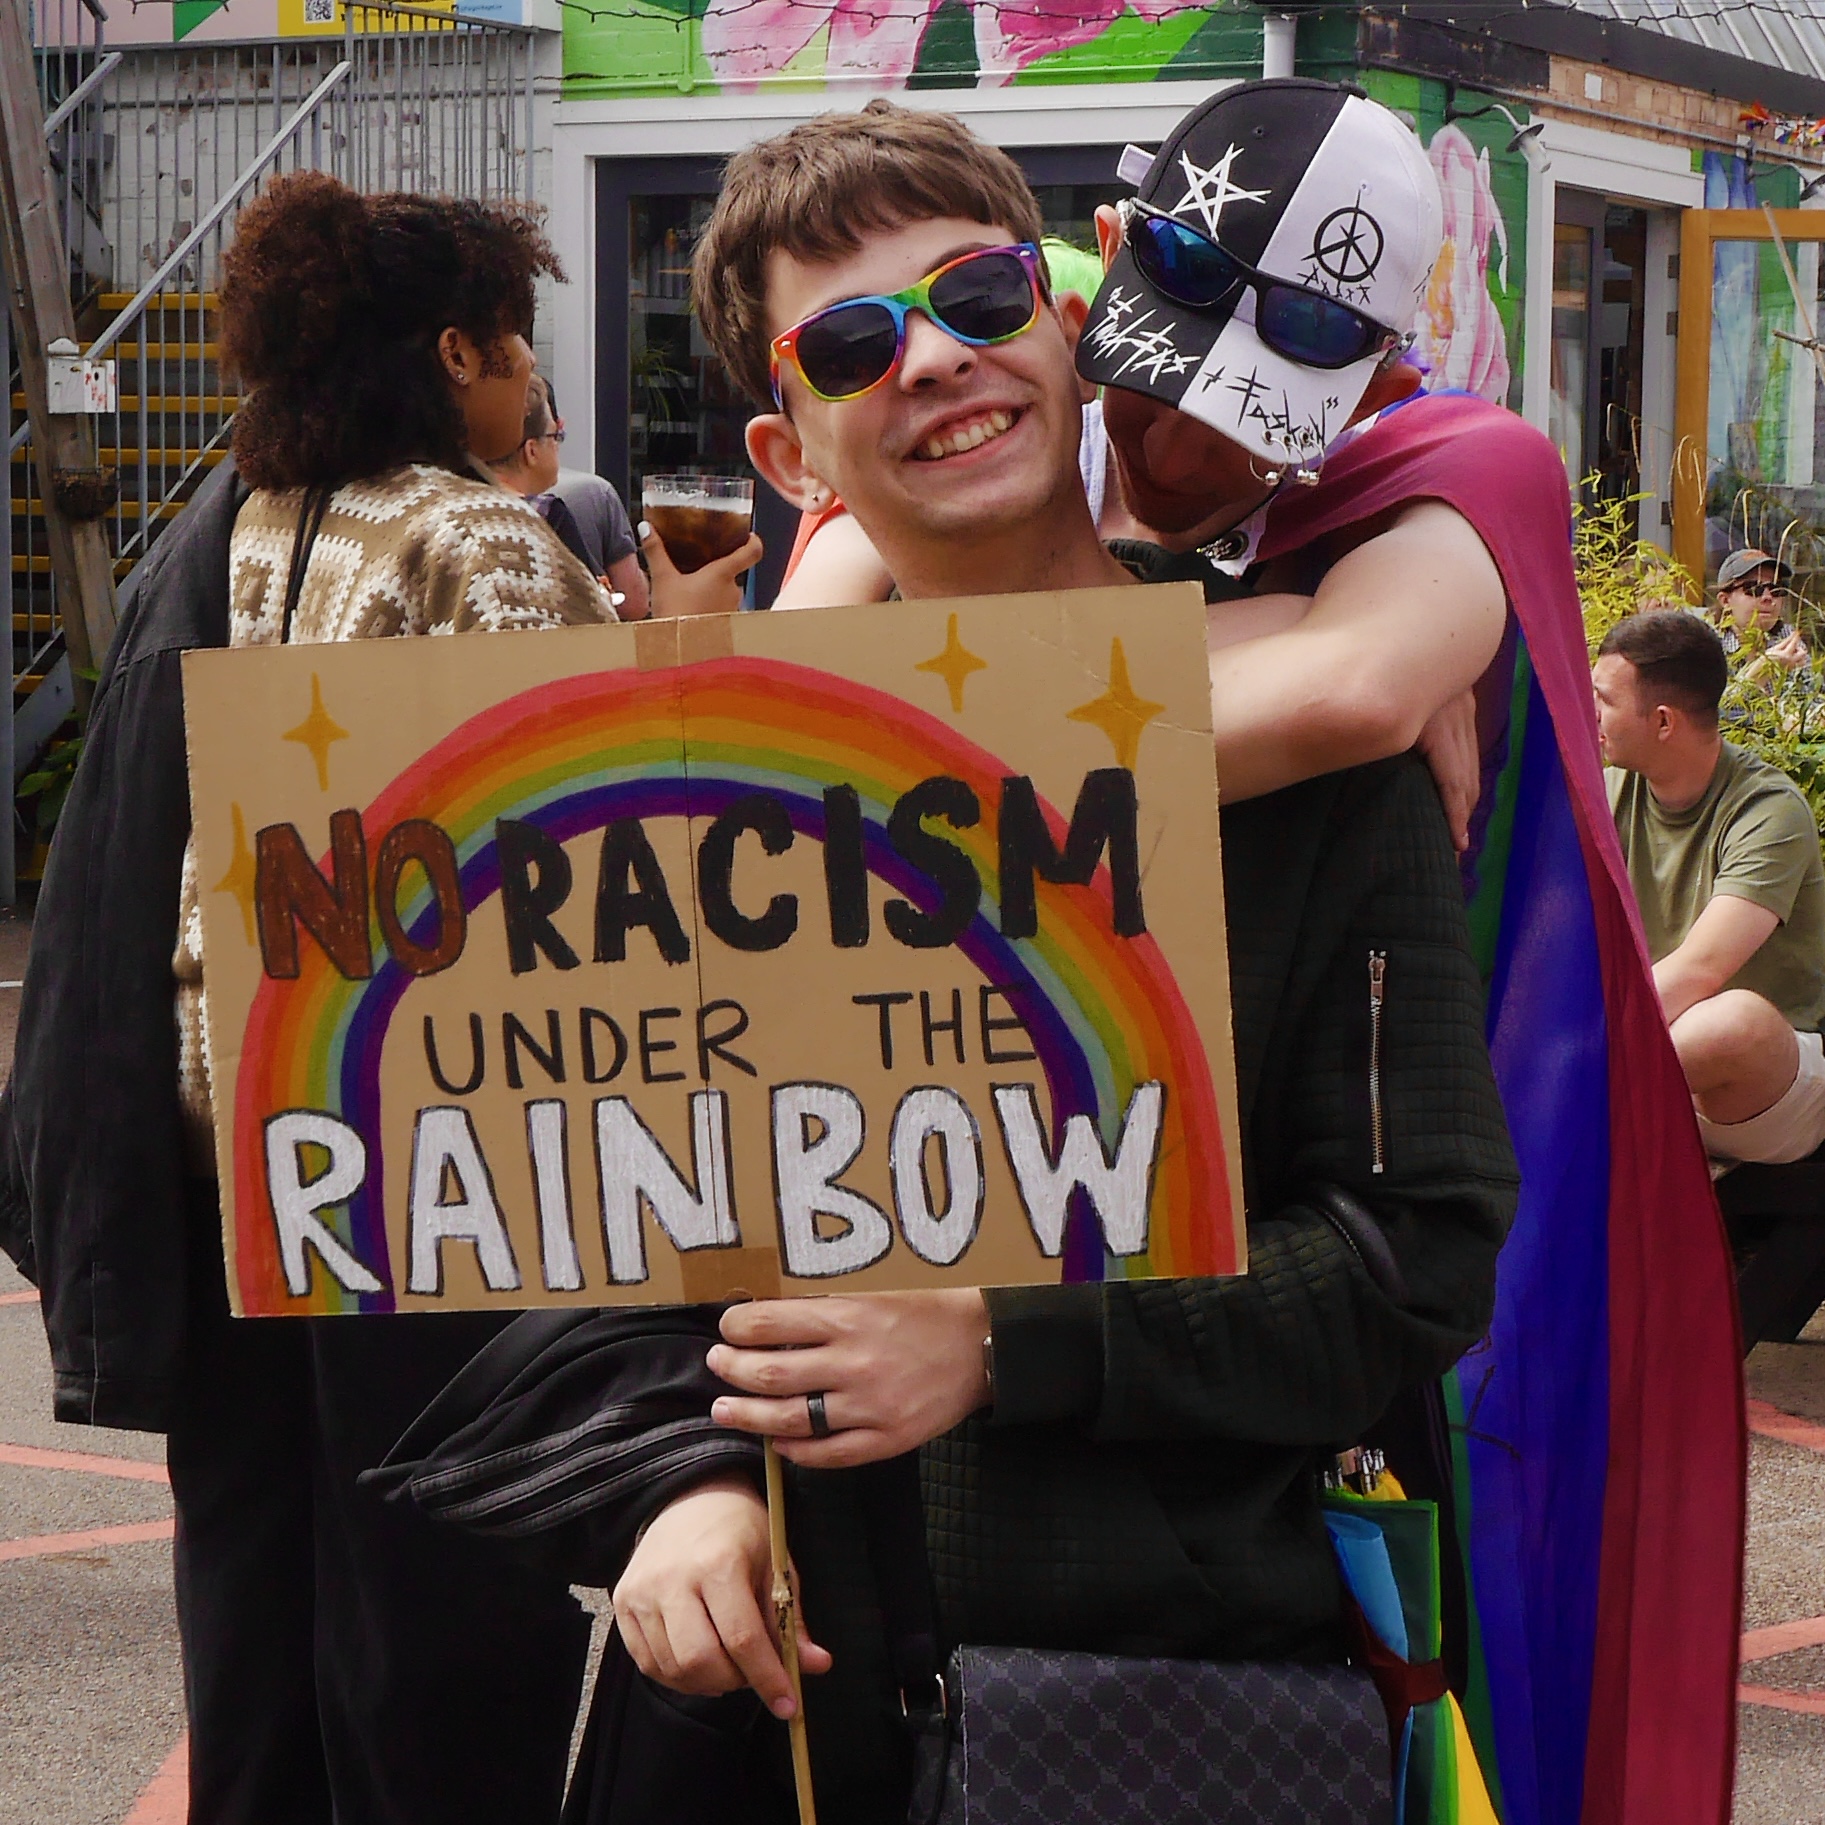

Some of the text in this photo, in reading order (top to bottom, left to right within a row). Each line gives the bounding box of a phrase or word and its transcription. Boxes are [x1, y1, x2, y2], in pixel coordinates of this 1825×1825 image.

[255, 767, 1147, 980] NO RACISM
[423, 984, 1037, 1096] UNDER THE
[262, 1078, 1167, 1297] RAINBOW
